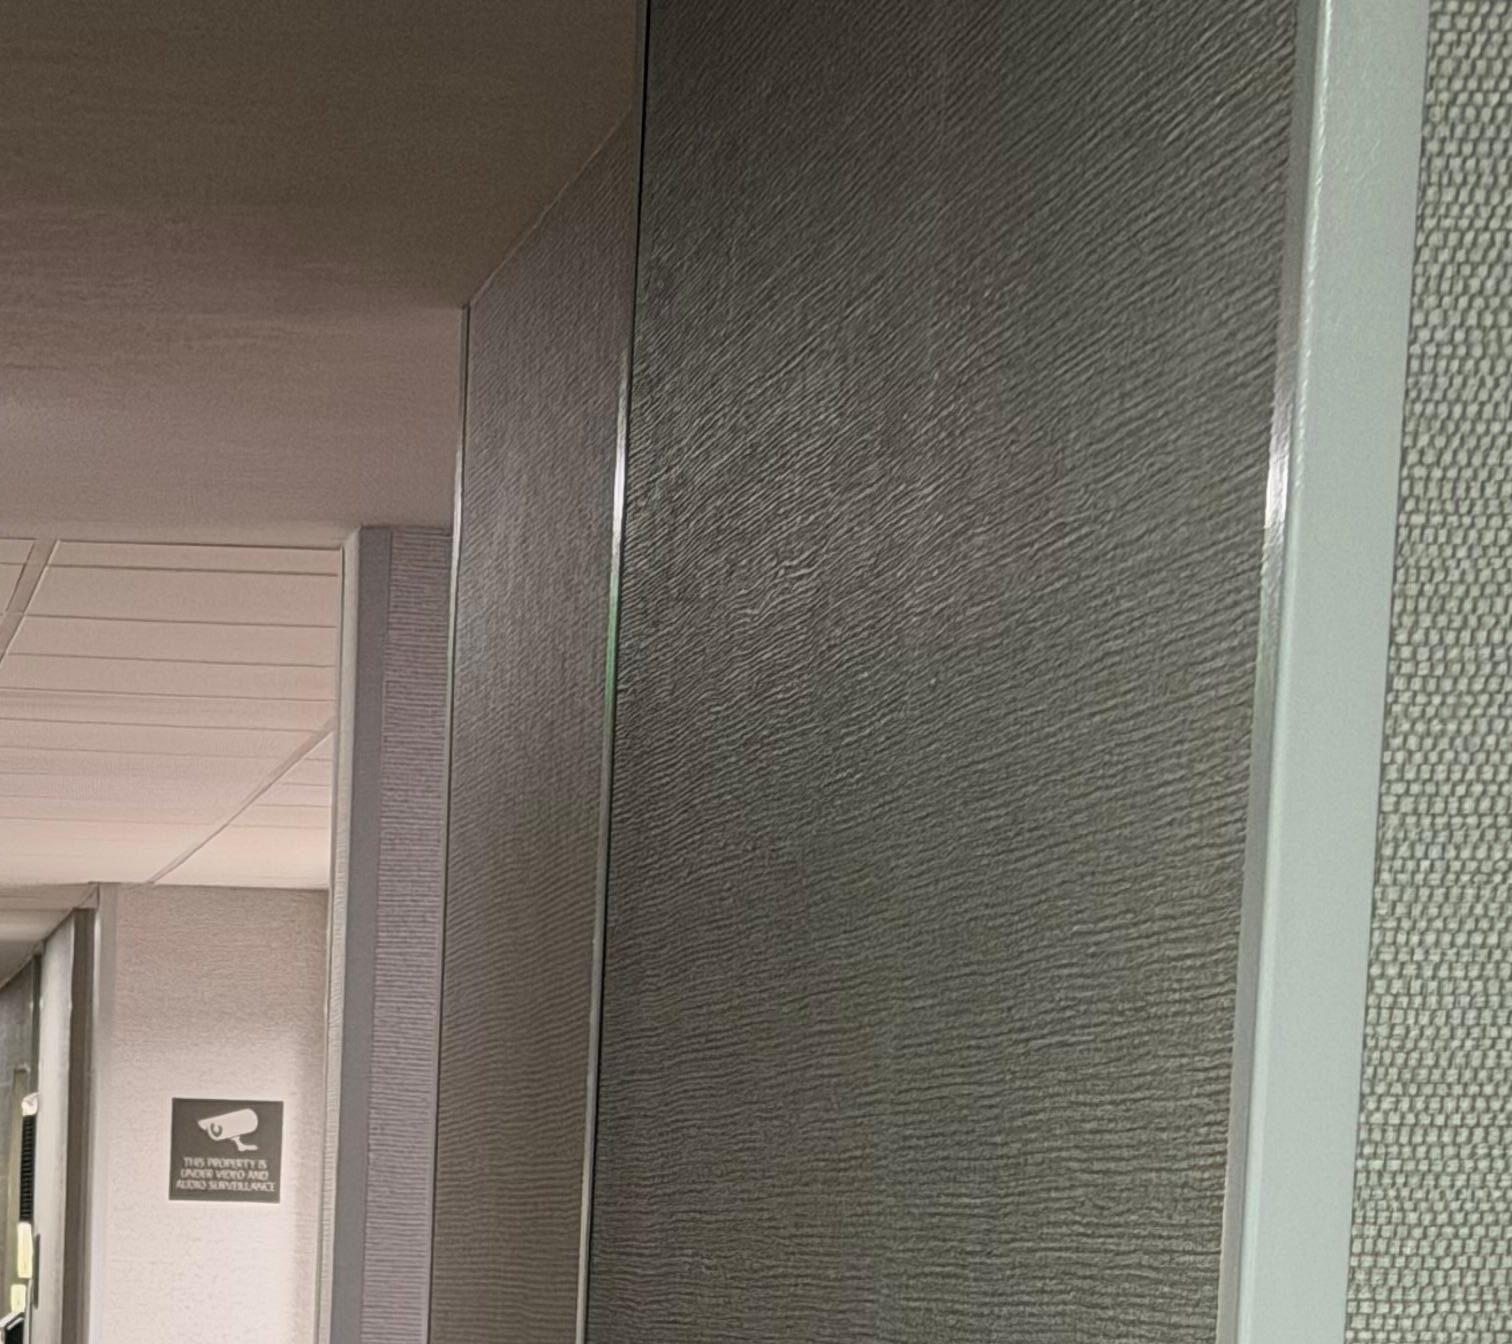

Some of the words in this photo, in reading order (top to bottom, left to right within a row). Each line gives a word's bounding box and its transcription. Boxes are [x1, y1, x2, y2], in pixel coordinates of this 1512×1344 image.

[183, 1157, 205, 1168] THIS
[207, 1158, 256, 1169] PROPERTY
[258, 1159, 267, 1169] IS
[180, 1168, 214, 1178] UNDER
[215, 1169, 245, 1180] VIDEO
[247, 1170, 269, 1181] AND
[176, 1179, 207, 1190] AUDIO
[208, 1181, 276, 1192] SURVEILLANCE
